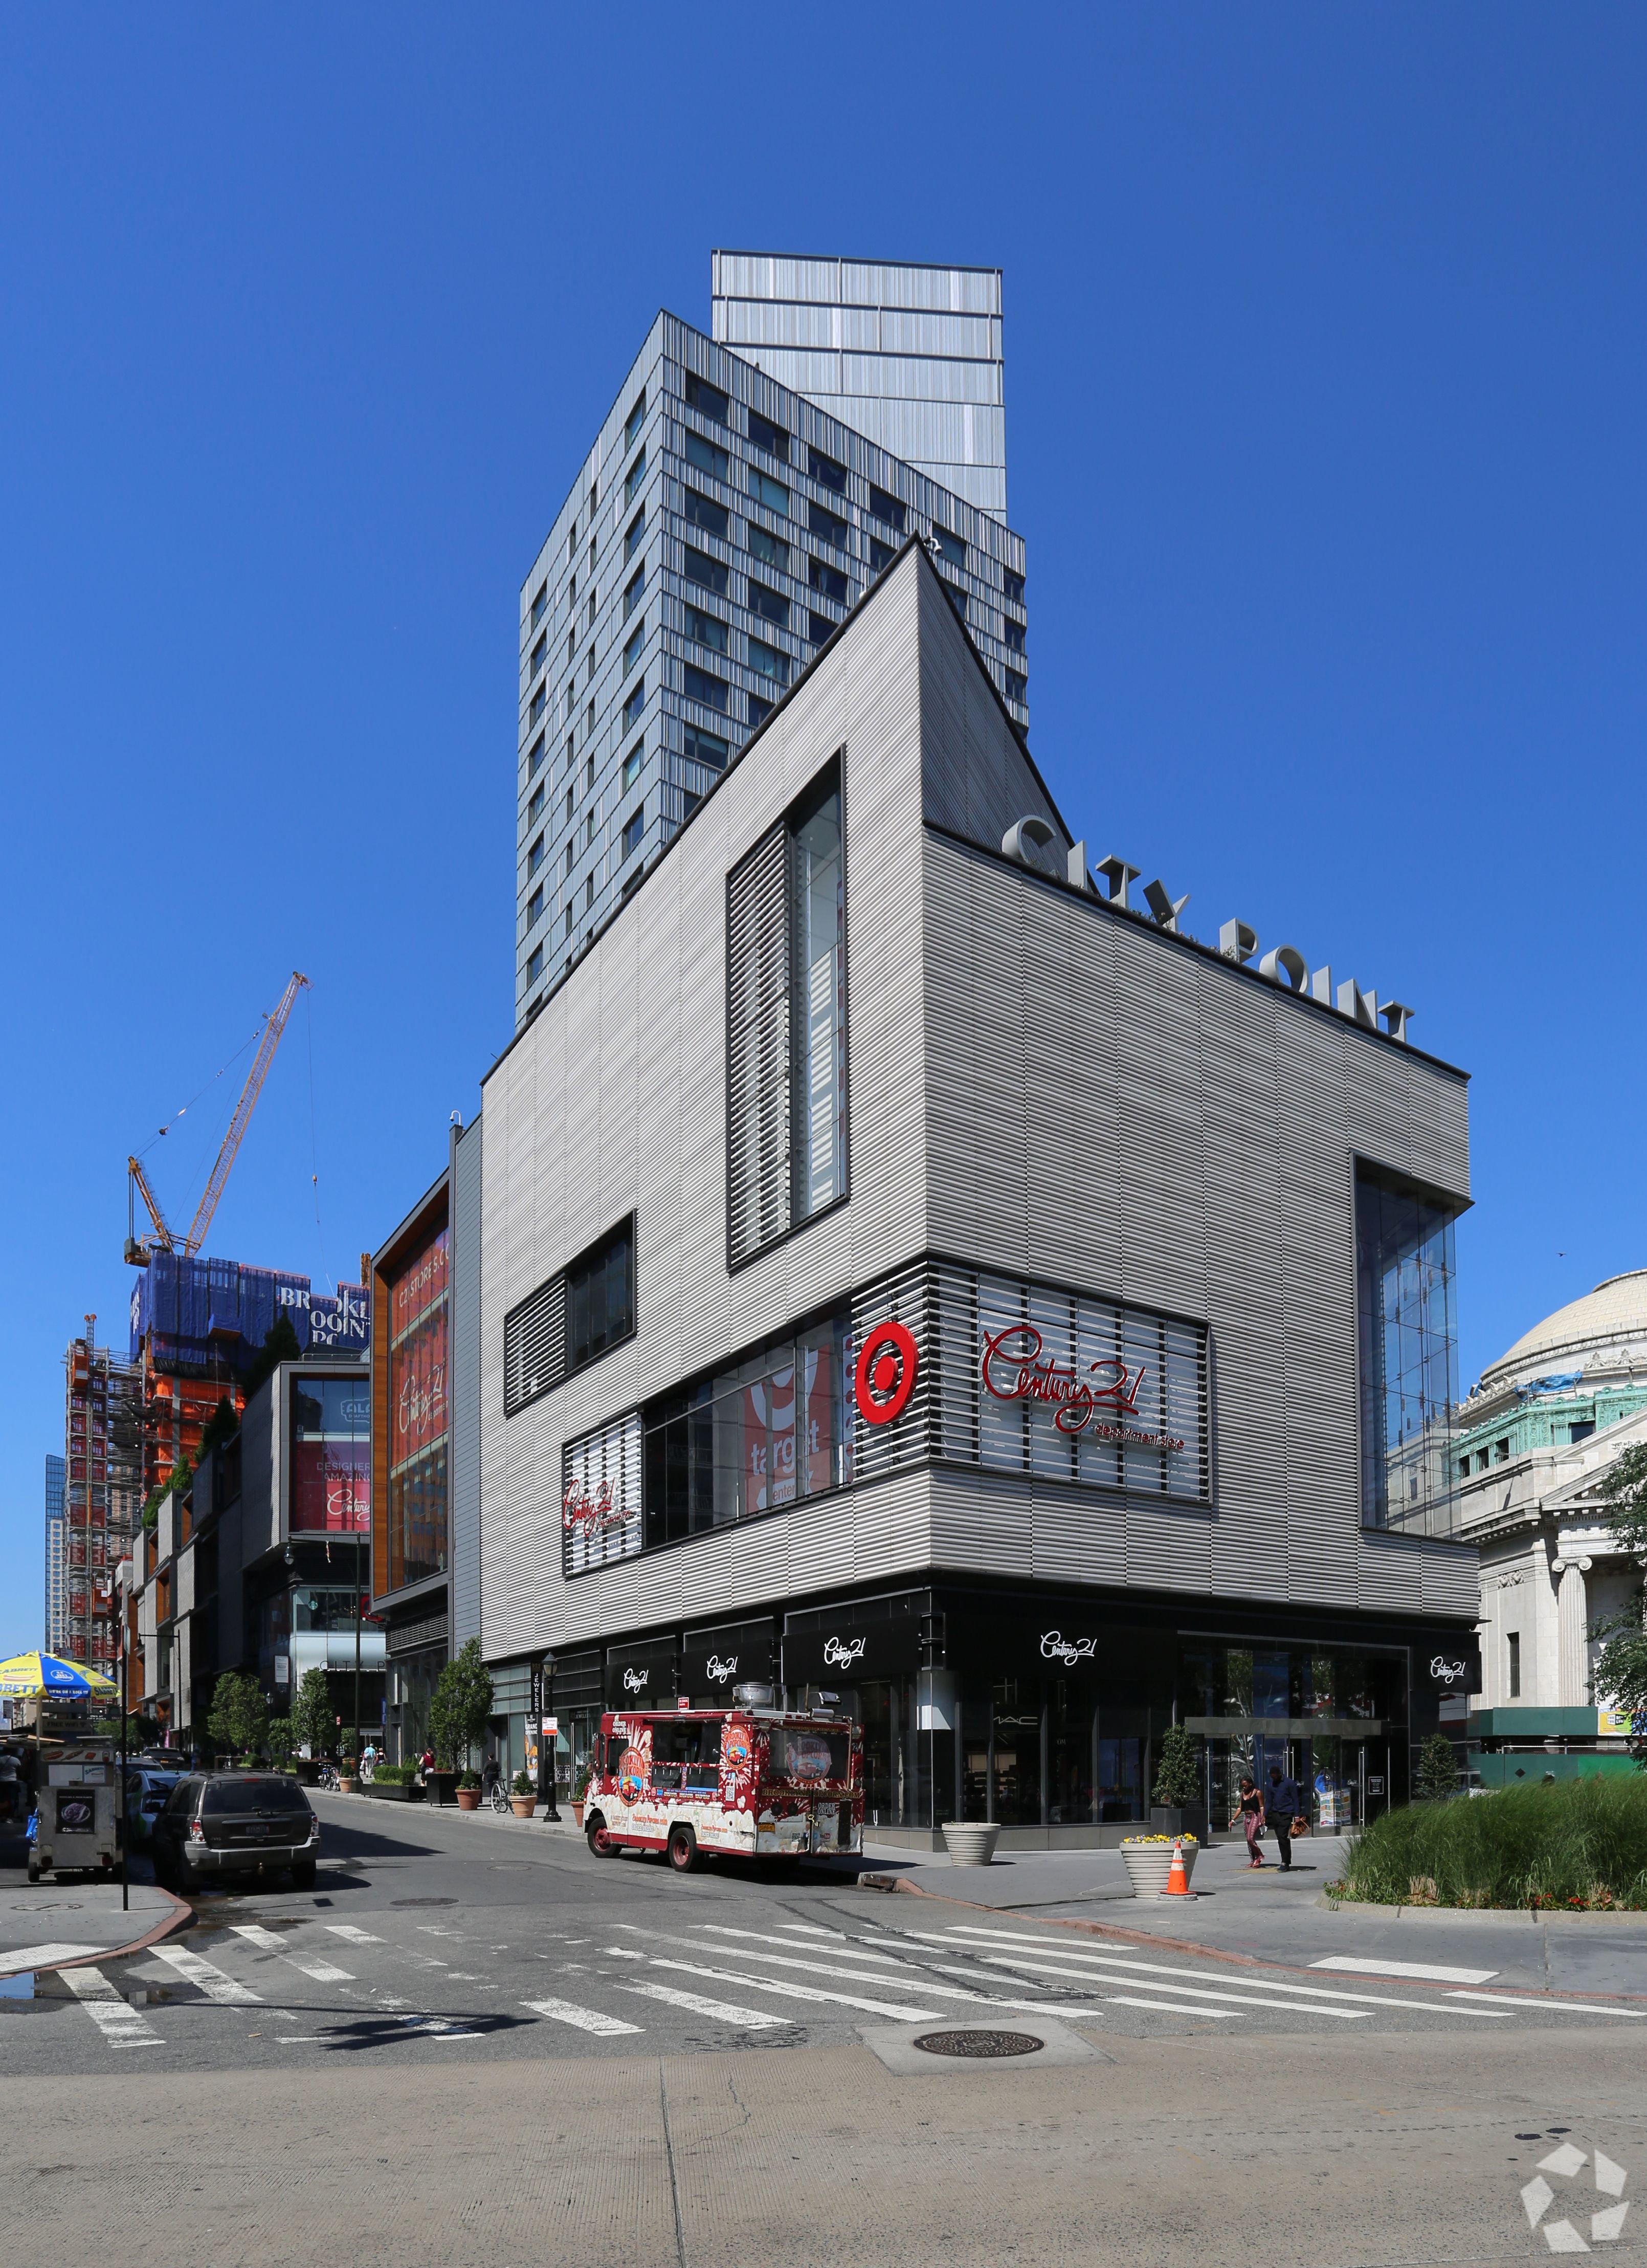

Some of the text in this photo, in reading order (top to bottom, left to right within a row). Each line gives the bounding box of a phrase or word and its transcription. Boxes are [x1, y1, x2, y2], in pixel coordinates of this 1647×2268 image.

[1002, 814, 1415, 1043] CITY POINT
[982, 1326, 1146, 1433] Century 21
[751, 1419, 819, 1476] targt
[1095, 1422, 1185, 1449] department store
[327, 1489, 370, 1522] Century
[563, 1477, 615, 1537] Century 21
[824, 1637, 866, 1669] Century 21
[1040, 1631, 1098, 1666] Century 21
[624, 1668, 649, 1693] Century 21
[706, 1655, 738, 1684] Century 21
[1431, 1656, 1466, 1684] Century 21
